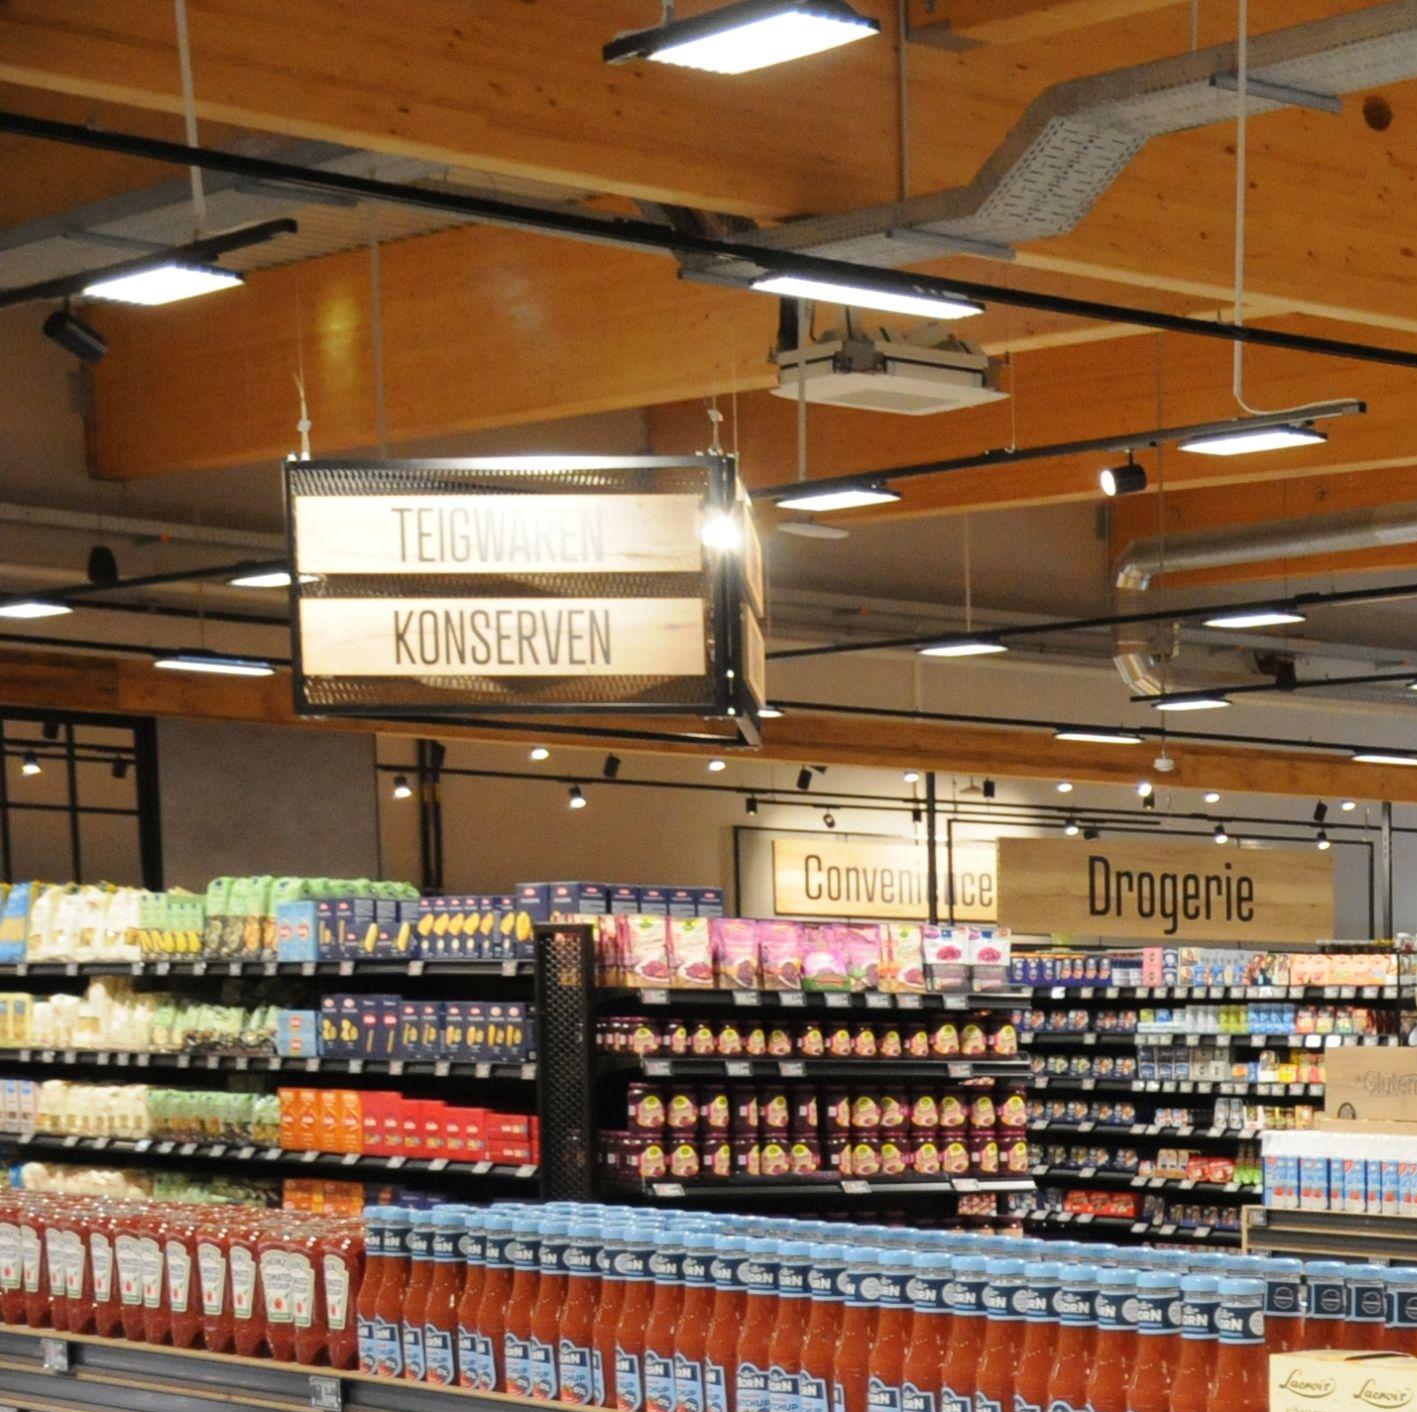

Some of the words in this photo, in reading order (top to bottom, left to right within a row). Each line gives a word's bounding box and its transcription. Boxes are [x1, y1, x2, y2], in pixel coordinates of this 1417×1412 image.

[390, 507, 605, 563] TEIGWAREN
[393, 608, 612, 666] KONSERVEN
[804, 853, 992, 908] Convenince
[1088, 855, 1255, 936] Drogerie
